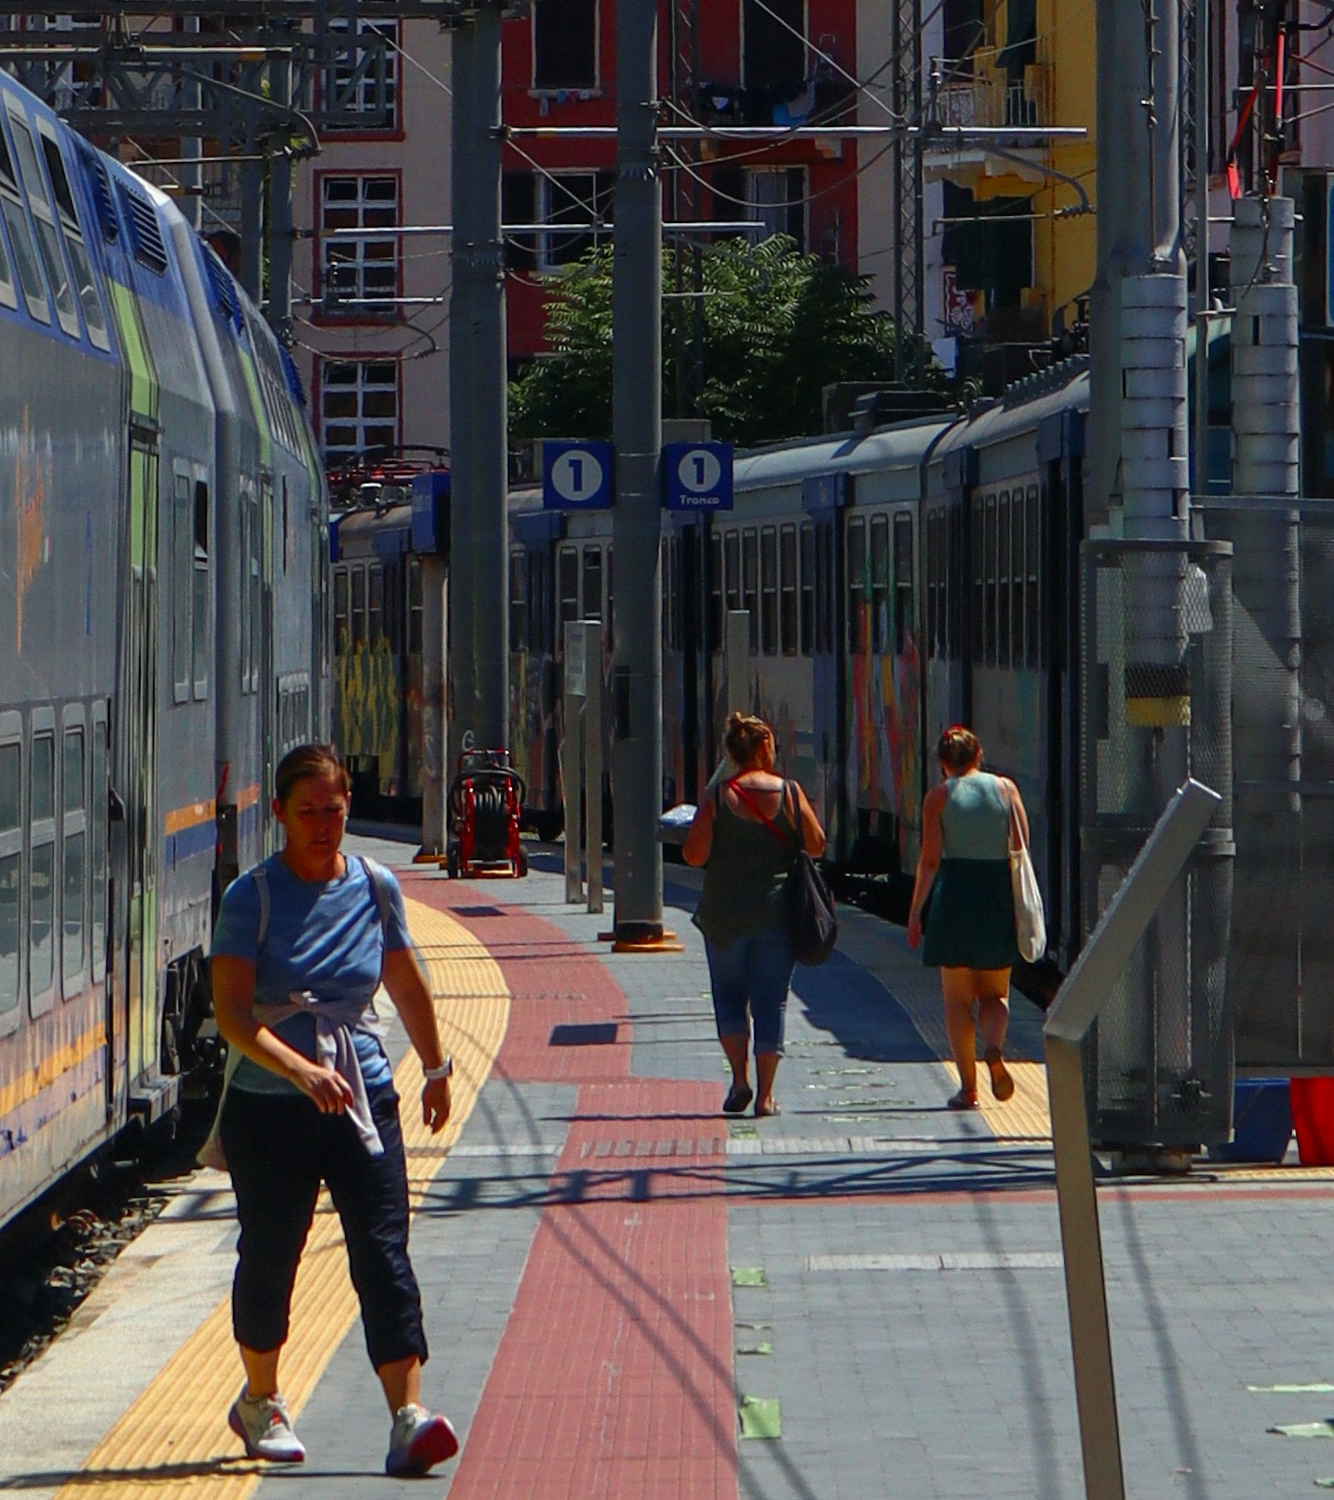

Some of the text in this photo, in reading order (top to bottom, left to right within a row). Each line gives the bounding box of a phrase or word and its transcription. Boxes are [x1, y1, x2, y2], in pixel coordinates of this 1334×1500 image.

[569, 458, 584, 492] 1
[692, 458, 704, 485] 1
[678, 494, 721, 506] Tronco
